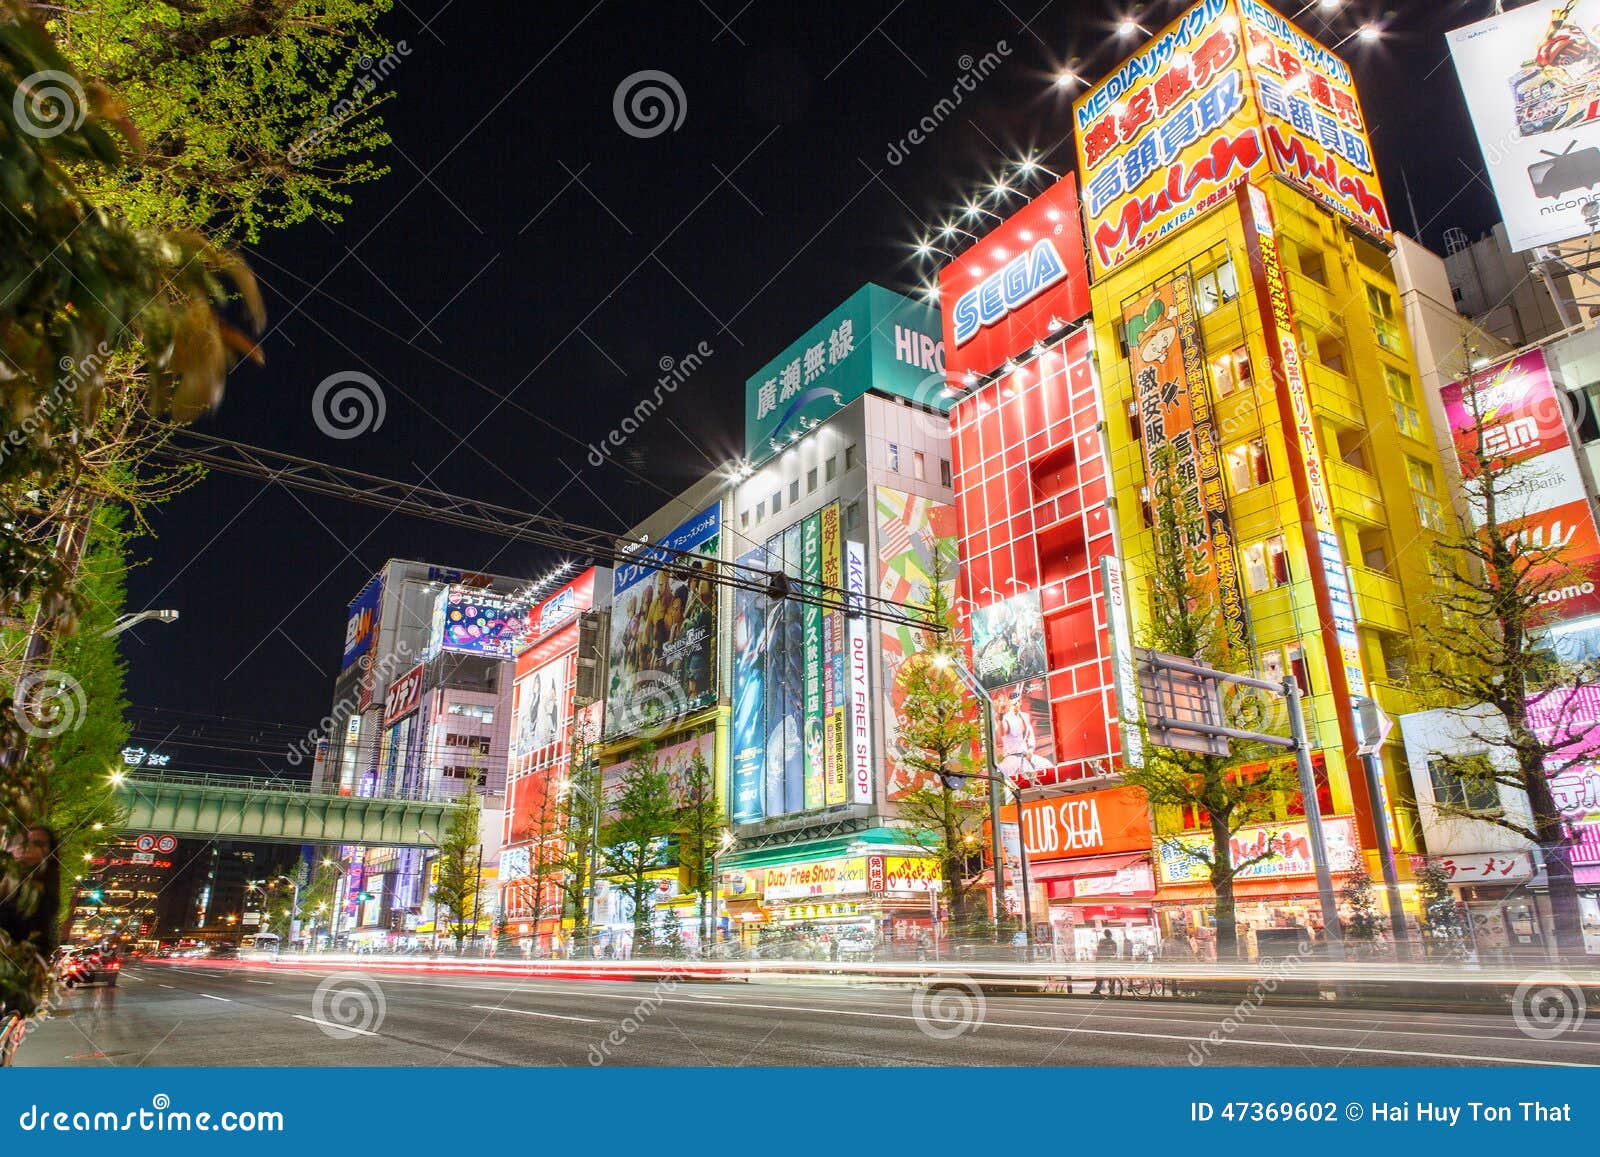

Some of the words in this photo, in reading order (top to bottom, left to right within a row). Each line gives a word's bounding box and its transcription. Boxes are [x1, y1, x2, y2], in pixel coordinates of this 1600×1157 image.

[1084, 30, 1239, 168] 激安販売
[1089, 72, 1243, 216] 高額買取
[1257, 75, 1370, 172] 高額買取
[1096, 130, 1262, 268] Mulan
[1267, 126, 1391, 231] Mulan
[1159, 208, 1195, 235] AKIBA
[1324, 195, 1350, 216] AKIBA
[954, 239, 1067, 348] SEGA
[1502, 471, 1567, 502] SoftBank
[617, 540, 669, 587] ソフップ
[1524, 581, 1596, 608] como
[853, 637, 865, 686] DUTY
[855, 691, 867, 738] FREE
[857, 743, 868, 795] SHOP
[1021, 805, 1059, 853] CLUB
[1060, 798, 1104, 850] SEGA
[768, 869, 788, 888] Duty
[791, 867, 810, 884] Free
[812, 864, 836, 883] Shop
[870, 857, 883, 890] 免税店
[1443, 857, 1516, 880] ラーメン
